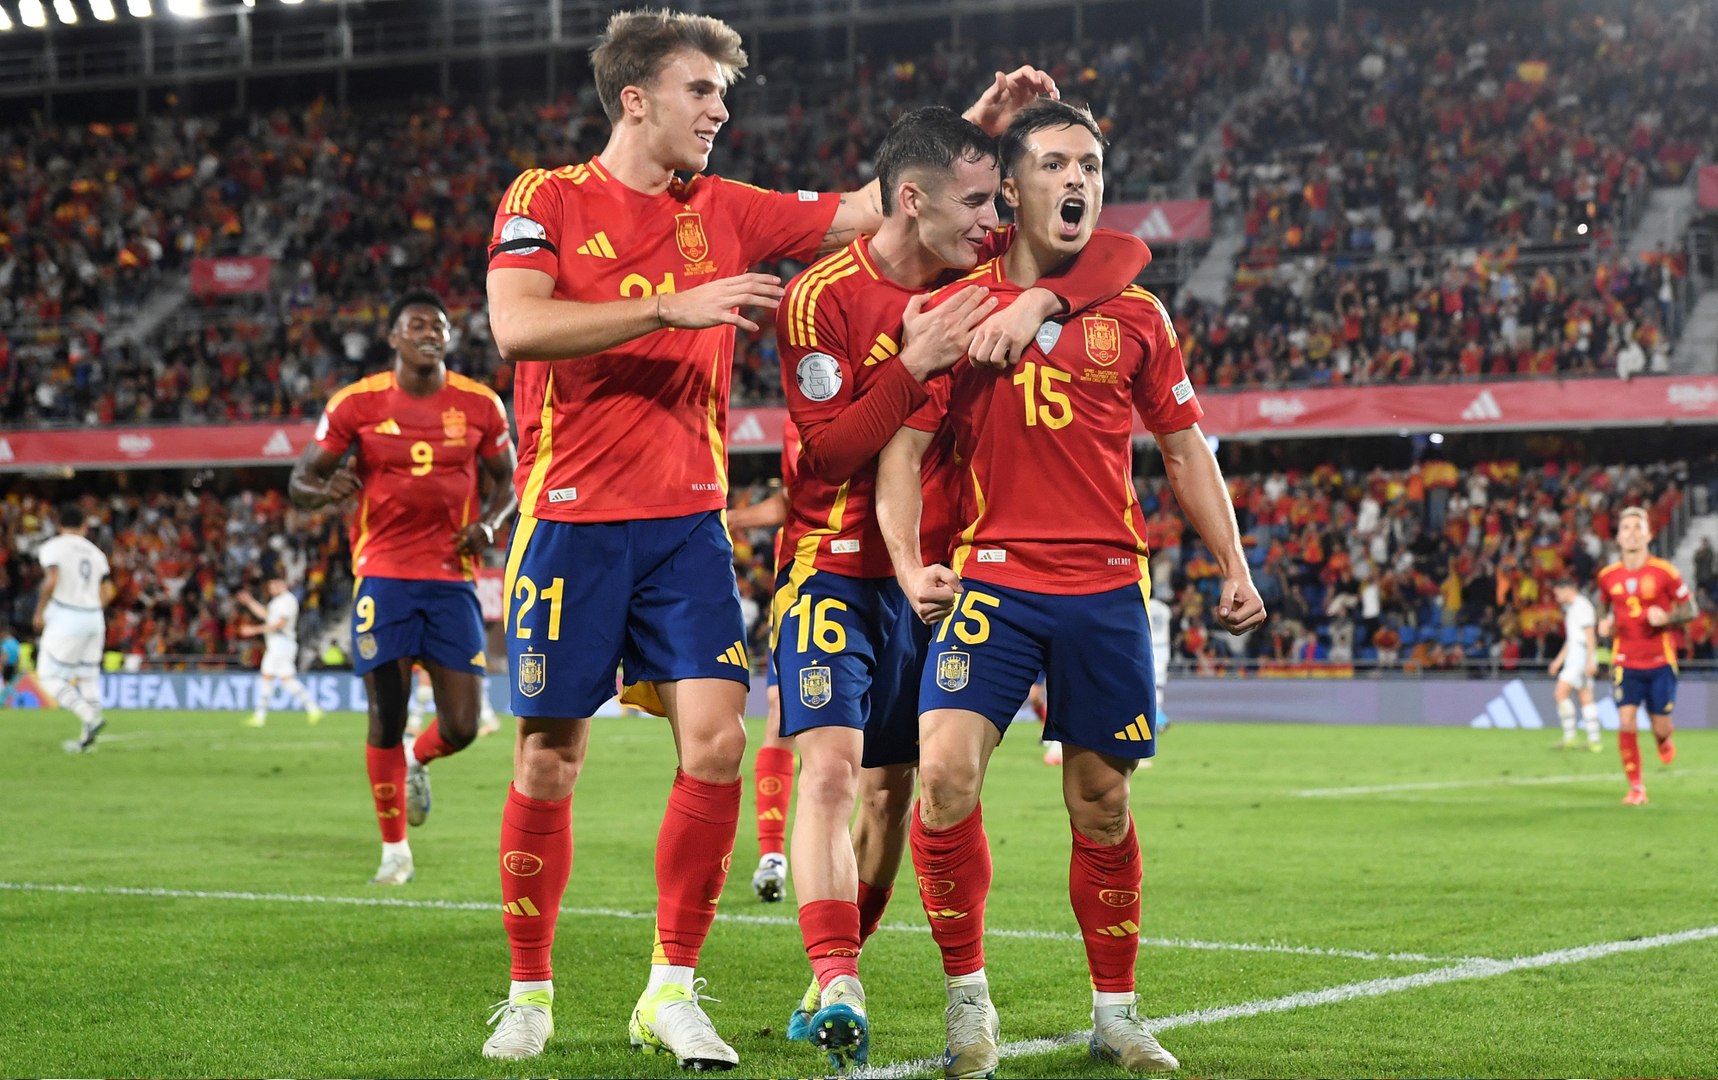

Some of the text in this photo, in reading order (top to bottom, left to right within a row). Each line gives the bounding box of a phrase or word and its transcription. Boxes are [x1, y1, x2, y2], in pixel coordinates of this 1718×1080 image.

[1013, 361, 1074, 430] 15
[409, 440, 433, 477] 9
[78, 558, 92, 583] 9
[355, 595, 375, 633] 9
[514, 575, 565, 641] 21
[789, 594, 848, 654] 16
[936, 590, 1001, 645] 15
[1625, 596, 1642, 618] 3
[98, 675, 180, 709] UEFA
